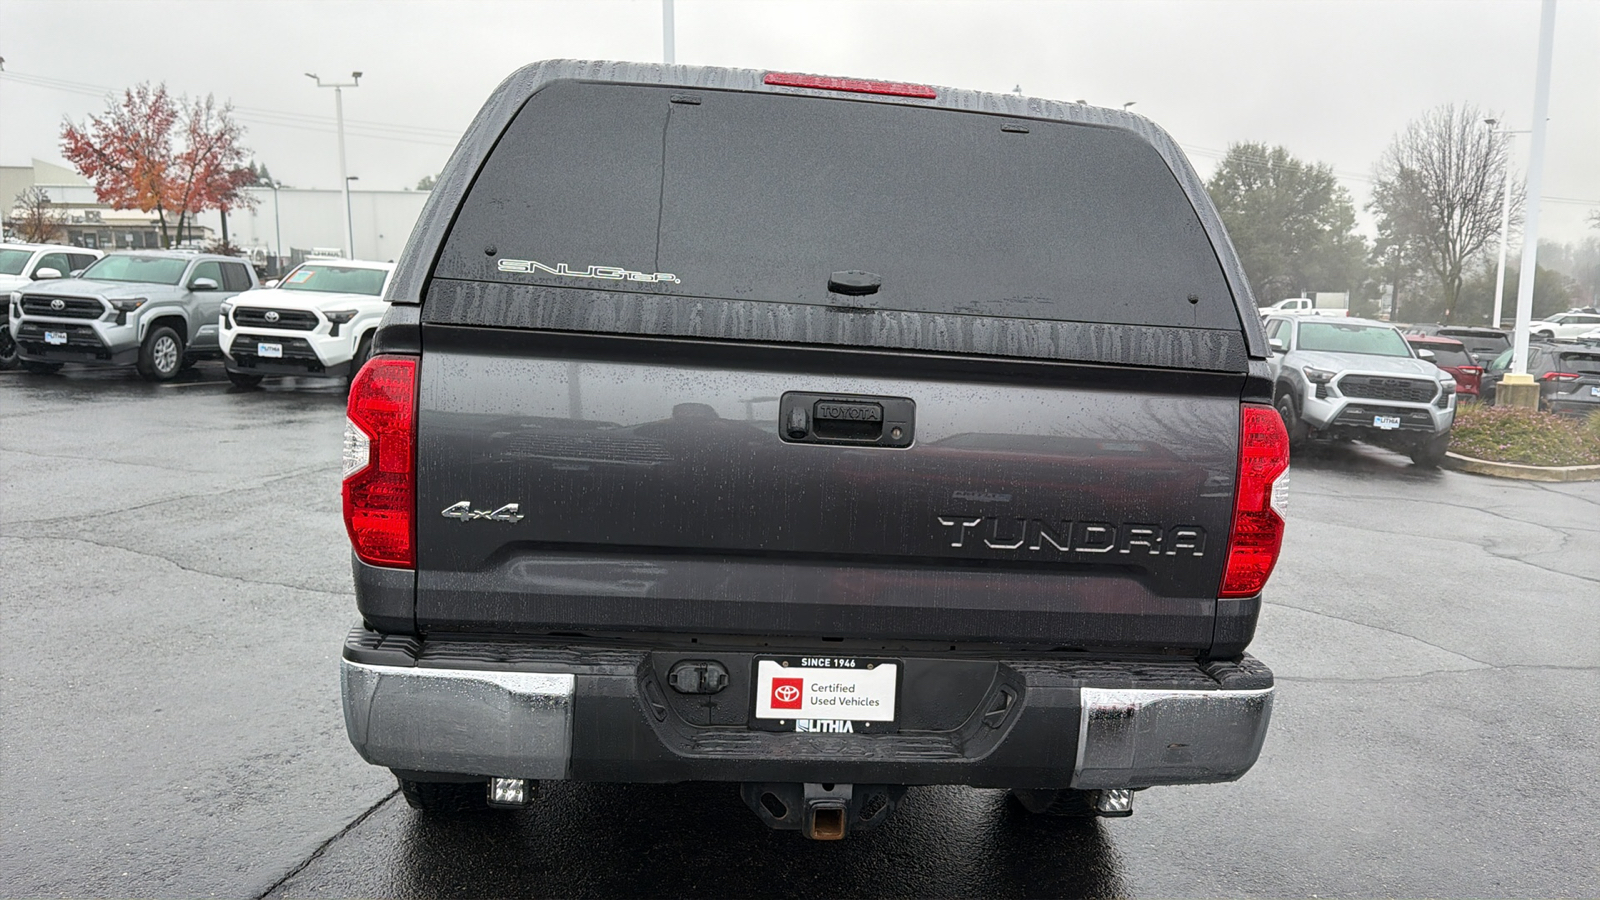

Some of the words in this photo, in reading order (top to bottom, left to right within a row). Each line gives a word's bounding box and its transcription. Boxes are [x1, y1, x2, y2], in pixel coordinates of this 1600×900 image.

[821, 406, 878, 420] TOYOTA
[937, 516, 1208, 556] TUNDRA
[801, 658, 831, 667] SINCE
[833, 659, 856, 668] 1946
[811, 683, 856, 693] Certified
[810, 697, 836, 706] Used
[838, 697, 880, 707] Vehicles
[809, 720, 854, 734] LITHIA
